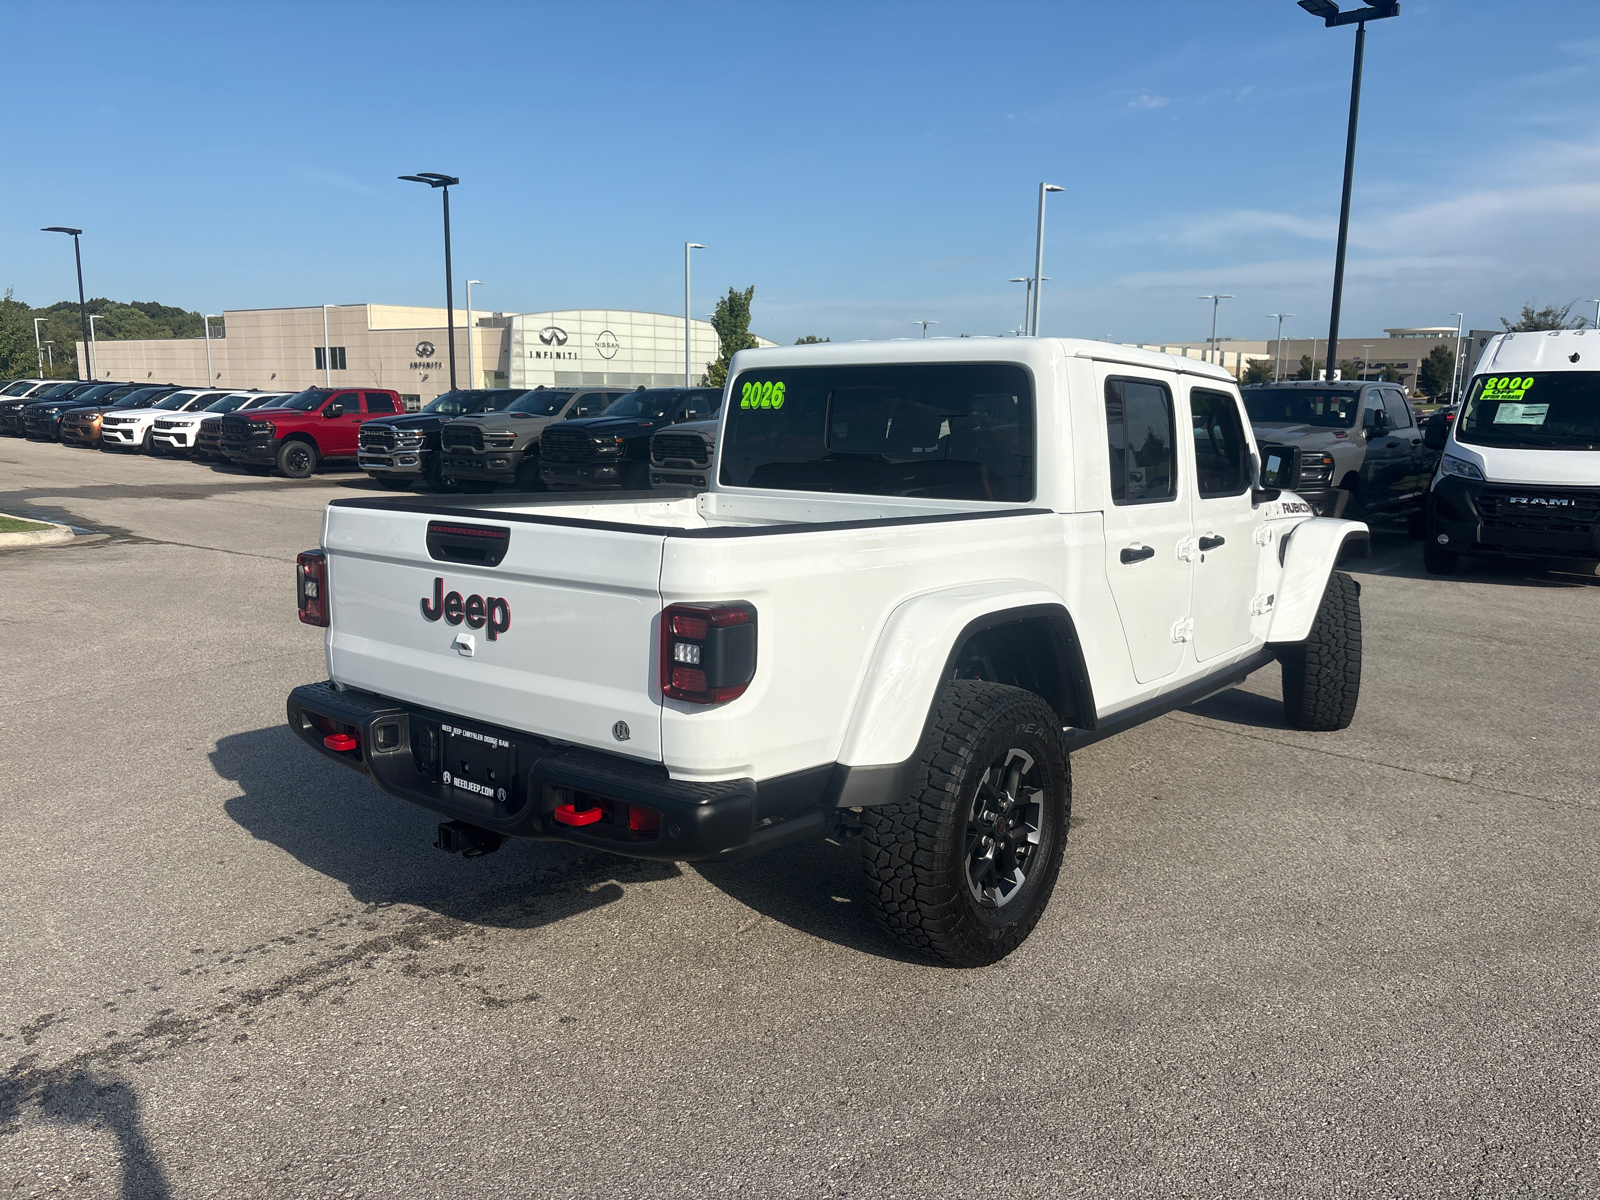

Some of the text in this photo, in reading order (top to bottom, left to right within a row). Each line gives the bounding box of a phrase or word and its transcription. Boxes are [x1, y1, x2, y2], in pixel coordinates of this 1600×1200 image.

[529, 350, 578, 360] INFINITI
[409, 361, 442, 370] INFINITI
[1485, 377, 1535, 390] 8000
[740, 381, 786, 410] 2026
[1509, 496, 1569, 506] RAM
[420, 576, 511, 641] Jeep
[441, 724, 452, 733] REED
[463, 730, 483, 741] CHRYSLER
[483, 735, 498, 745] DODGE
[498, 739, 509, 748] RAM
[453, 777, 494, 798] REEDJEEP.COM
